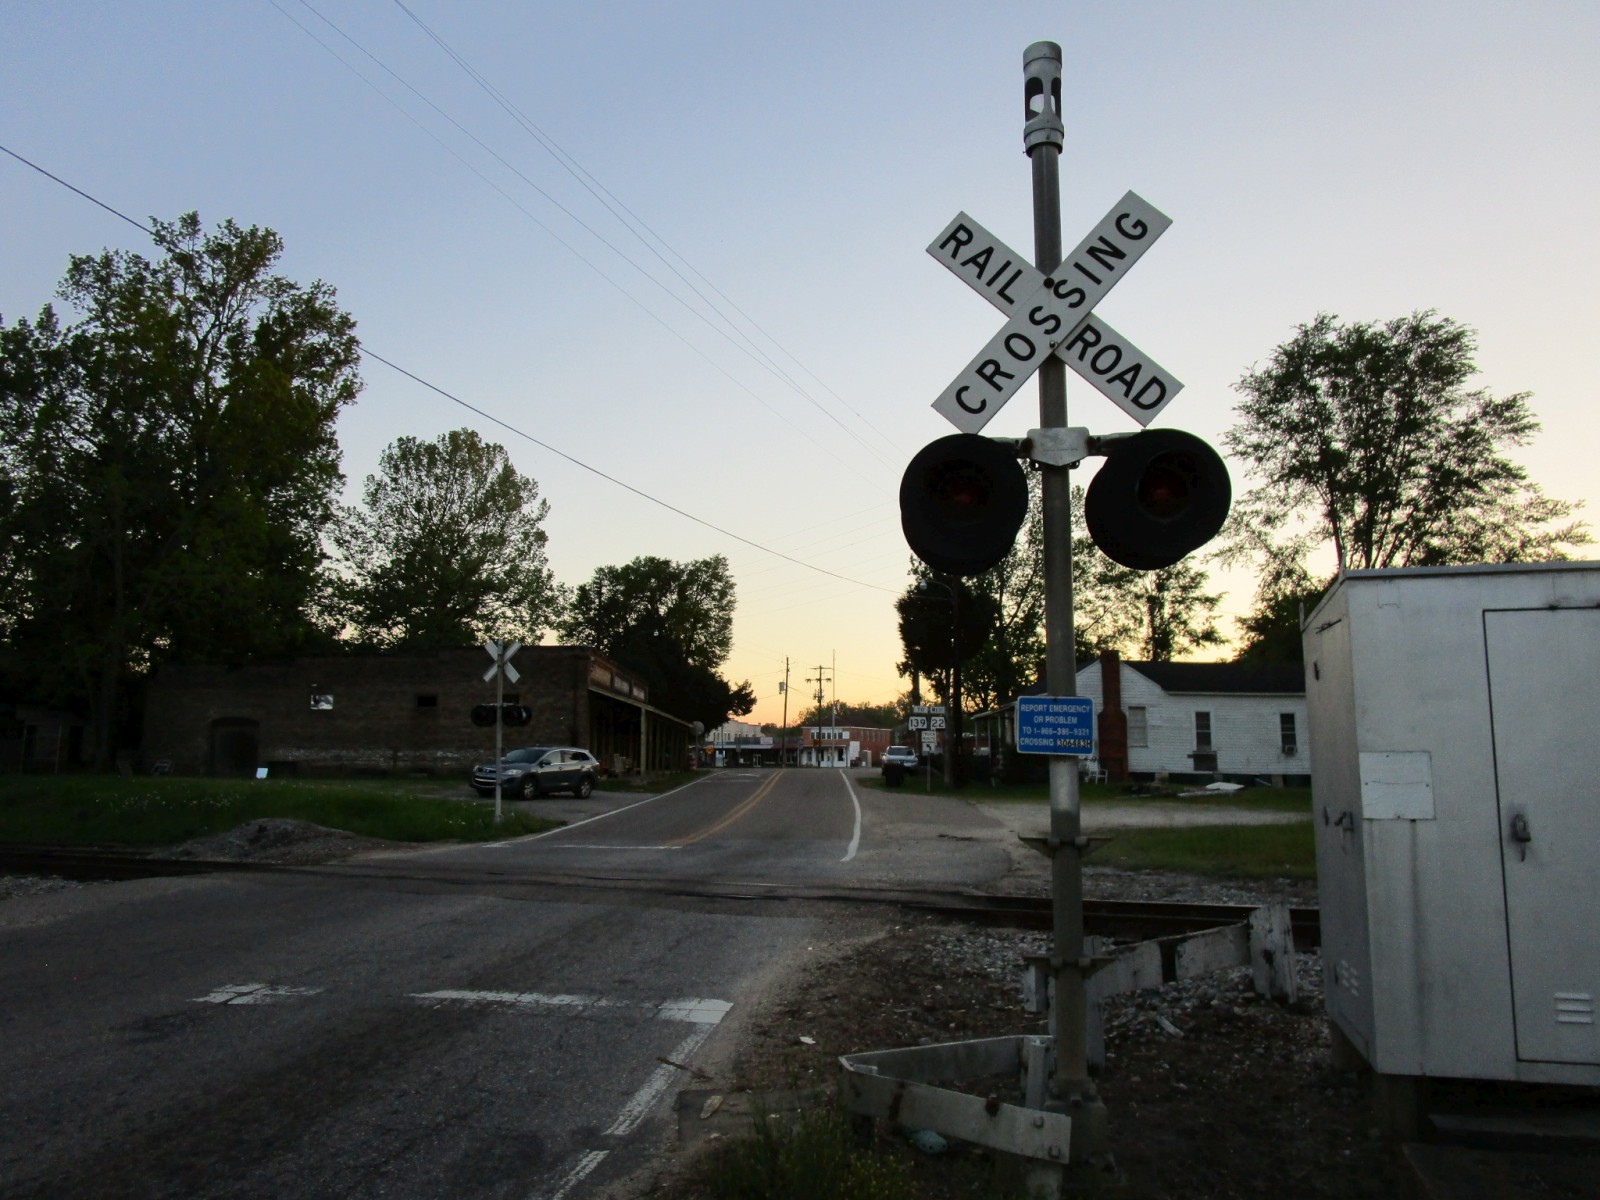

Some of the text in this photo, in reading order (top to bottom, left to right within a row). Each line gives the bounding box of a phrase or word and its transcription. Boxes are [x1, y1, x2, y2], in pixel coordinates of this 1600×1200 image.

[938, 223, 1167, 411] RAIL ROAD
[955, 212, 1148, 415] CROSSING
[1020, 704, 1090, 713] REPORT EMERGENCY
[910, 718, 926, 727] 139
[932, 718, 944, 727] 22
[1033, 715, 1078, 724] OR PROBLEM
[1022, 726, 1032, 734] TO
[1020, 737, 1054, 746] CROSSING
